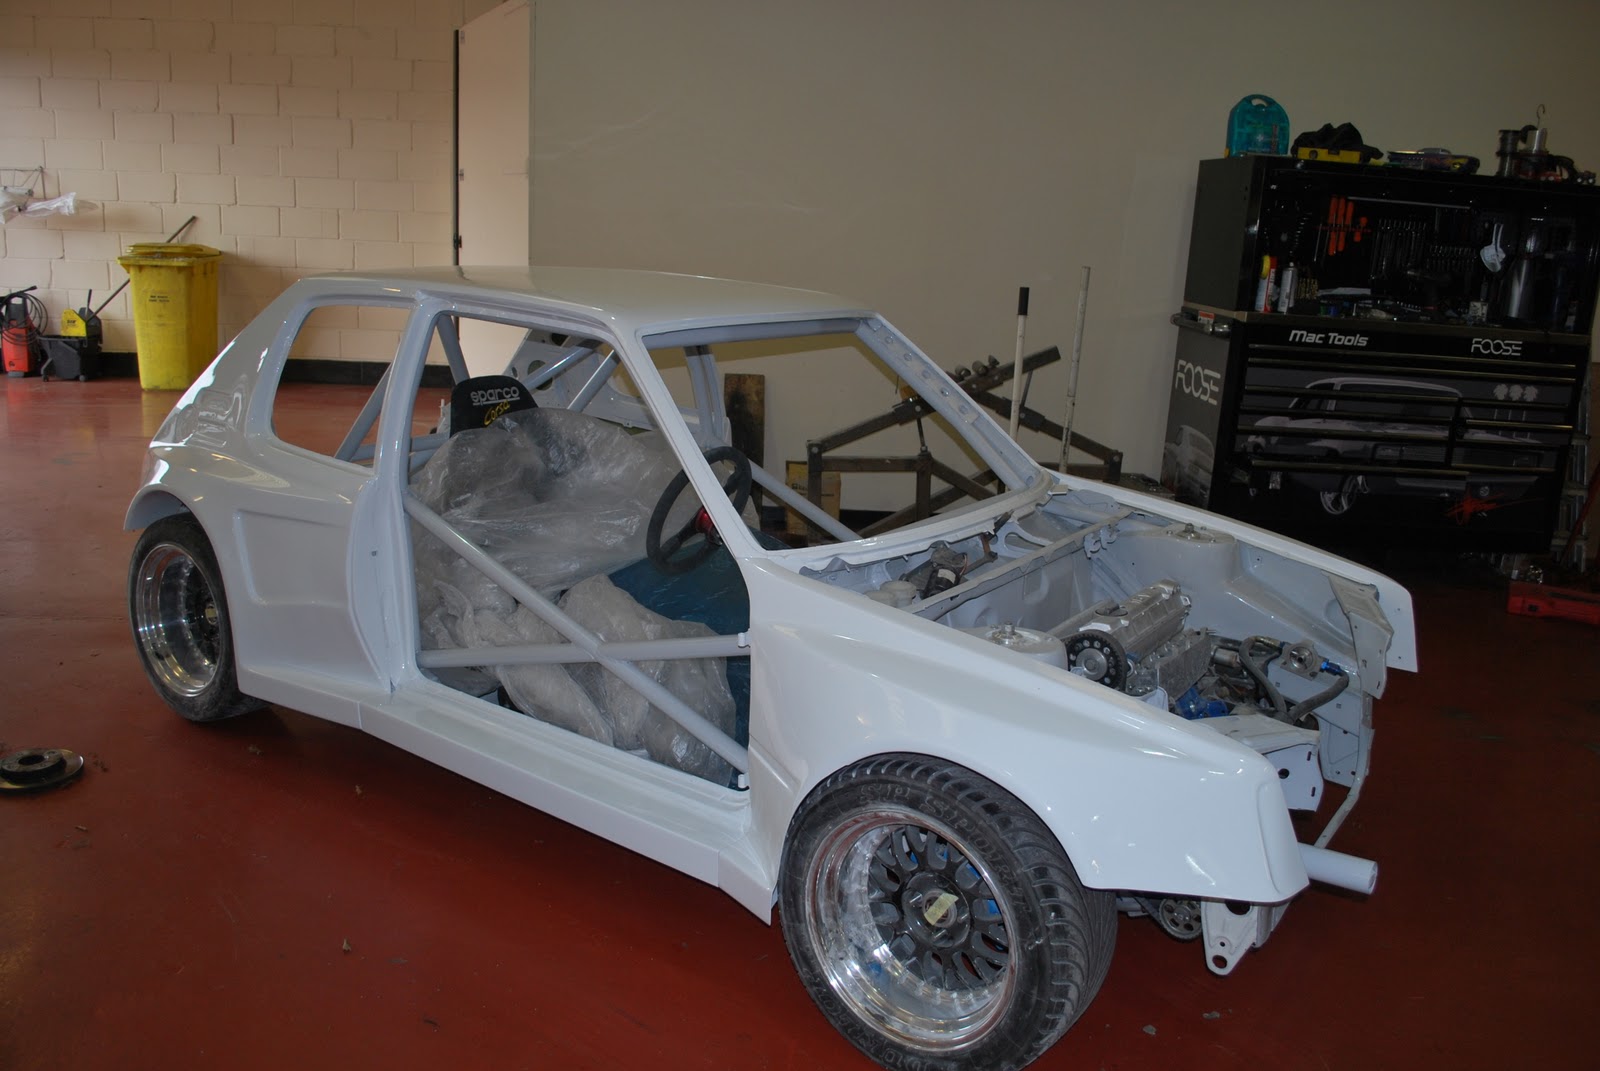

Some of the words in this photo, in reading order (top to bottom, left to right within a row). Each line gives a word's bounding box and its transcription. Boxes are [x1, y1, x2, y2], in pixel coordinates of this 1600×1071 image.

[1289, 330, 1325, 344] Mac
[1328, 332, 1369, 347] Tools
[1471, 338, 1523, 356] FOOSE
[1175, 359, 1221, 406] FOOSE
[470, 386, 520, 406] sparco
[484, 400, 511, 426] Corsa
